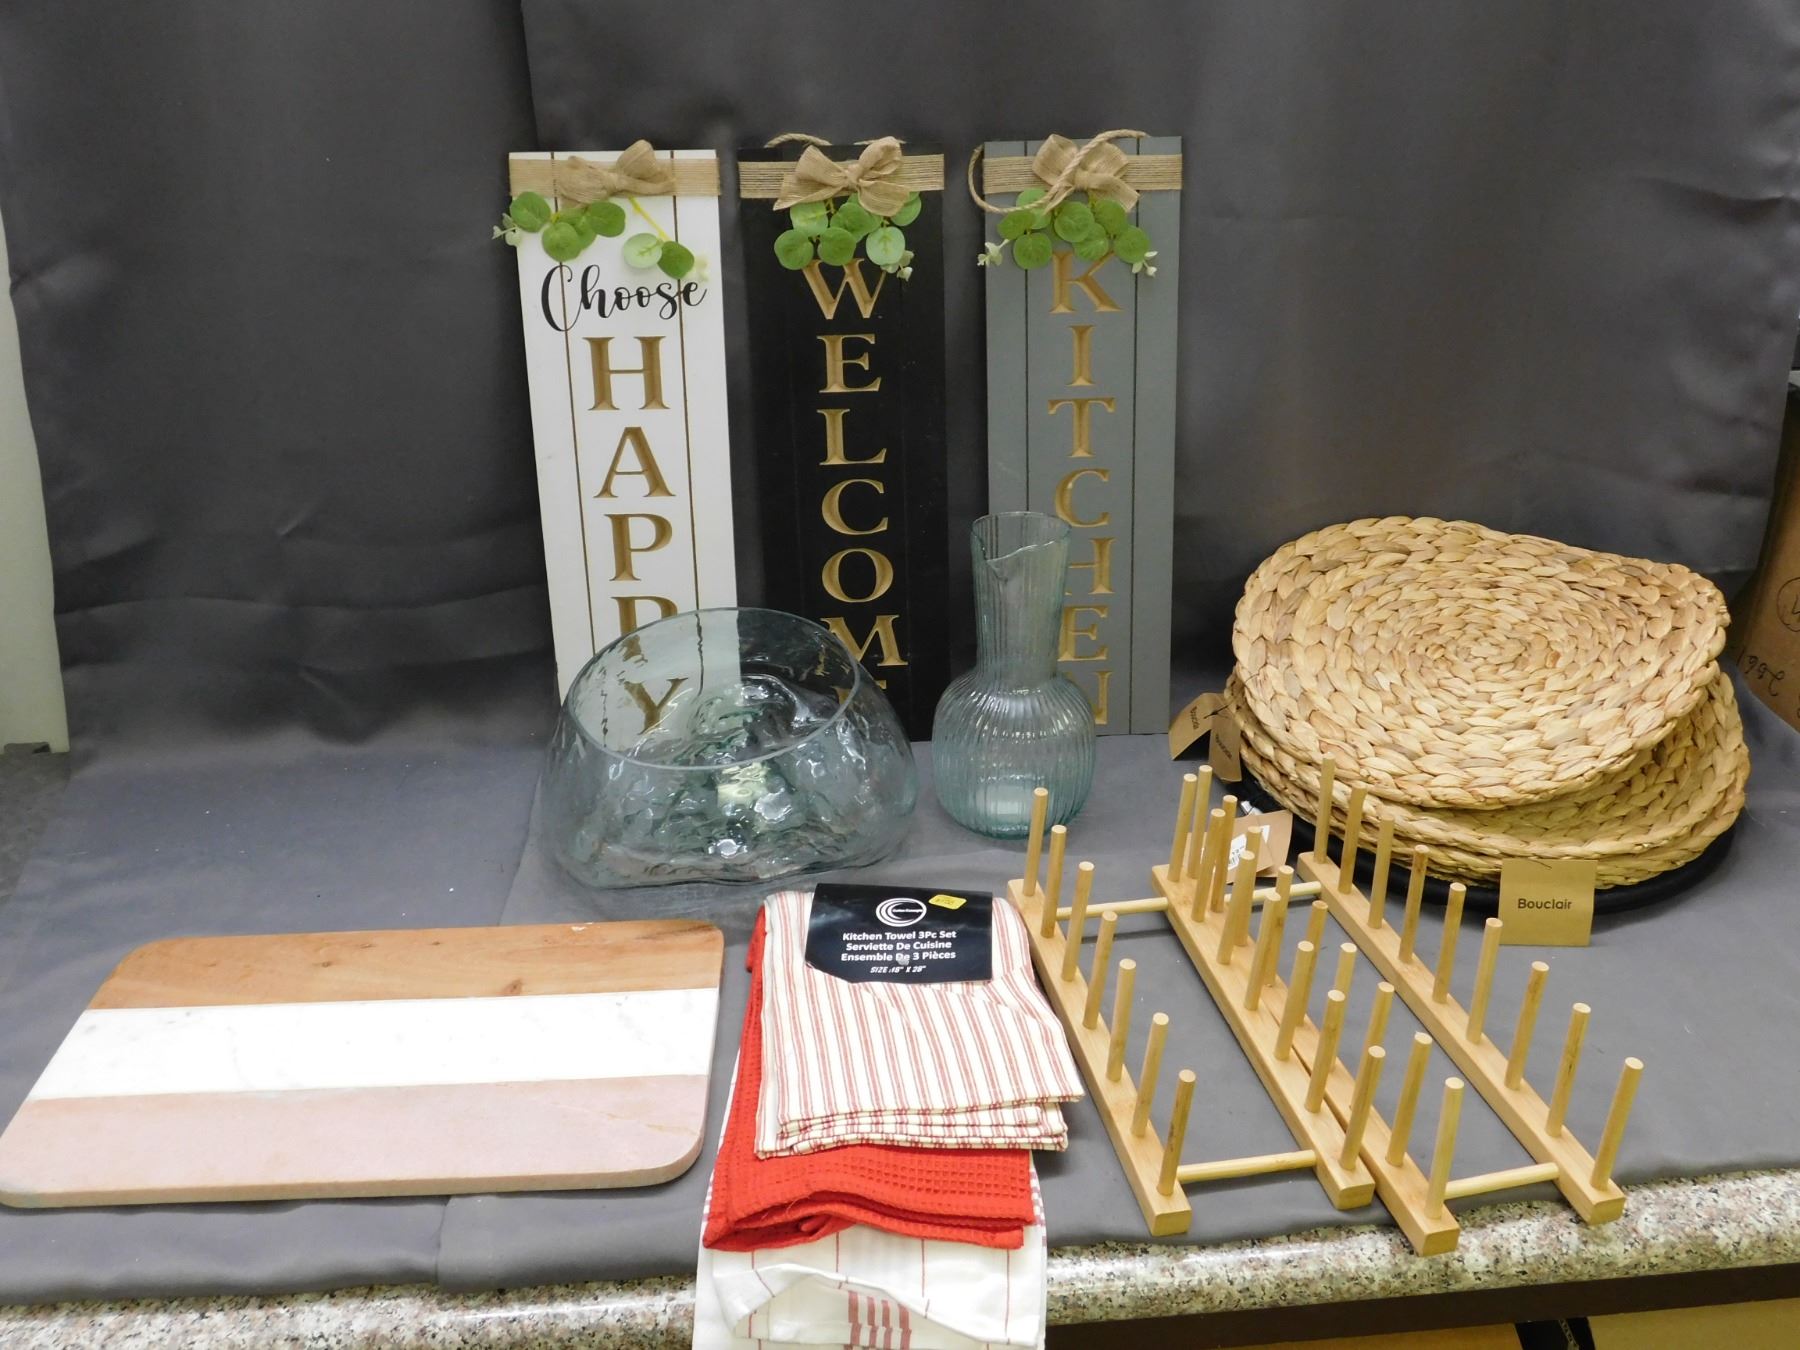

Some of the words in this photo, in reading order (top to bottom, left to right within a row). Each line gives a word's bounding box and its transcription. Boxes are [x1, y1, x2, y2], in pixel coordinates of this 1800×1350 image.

[541, 264, 707, 332] Choose
[801, 258, 909, 706] WELCOM
[1517, 898, 1573, 910] Bouclair
[842, 932, 883, 941] Kitchen
[885, 931, 916, 940] Towel
[918, 931, 937, 939] 3Pc
[939, 930, 957, 939] Set
[846, 942, 894, 951] Serviette
[896, 942, 911, 950] De
[913, 940, 952, 950] Cuisine
[841, 952, 893, 961] Ensemble
[895, 952, 911, 961] De
[912, 952, 920, 960] 3
[922, 951, 956, 960] Pièces
